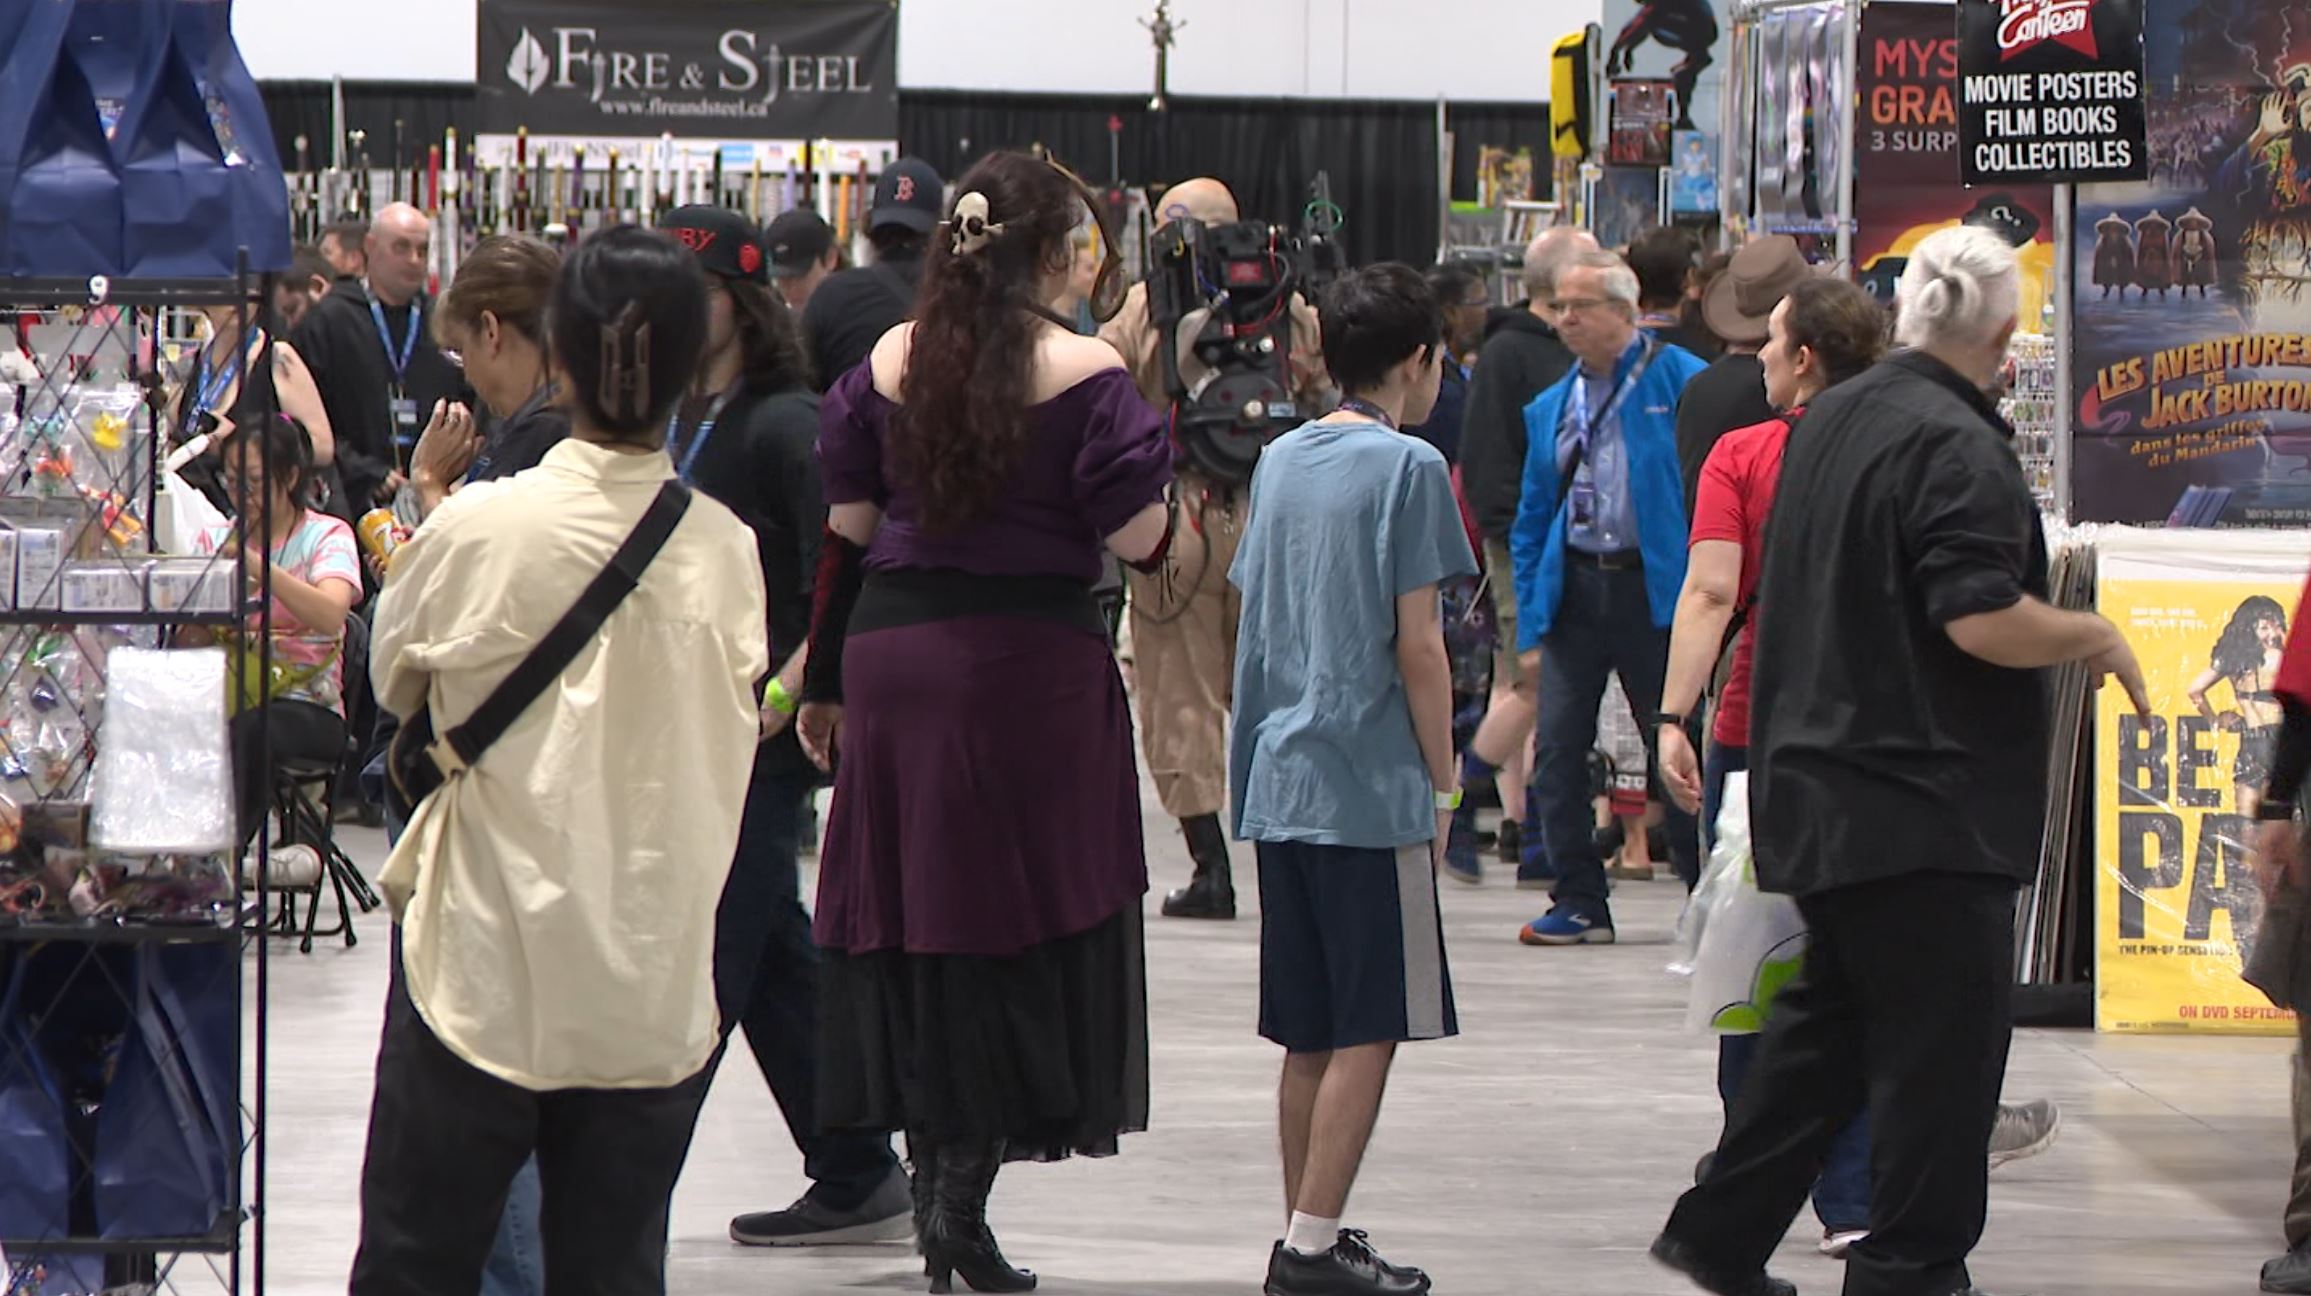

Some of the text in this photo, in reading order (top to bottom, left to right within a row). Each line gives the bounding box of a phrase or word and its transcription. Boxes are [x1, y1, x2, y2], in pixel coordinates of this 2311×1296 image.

[1997, 1, 2090, 48] Canteen
[1874, 38, 1958, 78] MYS
[679, 63, 705, 90] &
[1964, 70, 2137, 104] MOVIE POSTERS
[1871, 85, 1957, 125] GRA
[1985, 105, 2117, 137] FILM BOOKS
[1871, 131, 1958, 152] 3 SURP
[1975, 140, 2132, 172] COLLECTIBLES
[2098, 333, 2311, 402] LES AVENTURES
[2203, 369, 2227, 387] DE
[2140, 384, 2212, 430] JACK
[2130, 438, 2172, 455] dans
[2175, 431, 2200, 446] les
[2148, 435, 2257, 468] du Mandarin
[2119, 945, 2138, 955] THE
[2140, 945, 2174, 955] PIN-UP
[2179, 1005, 2198, 1018] ON
[2202, 1005, 2229, 1019] DVD
